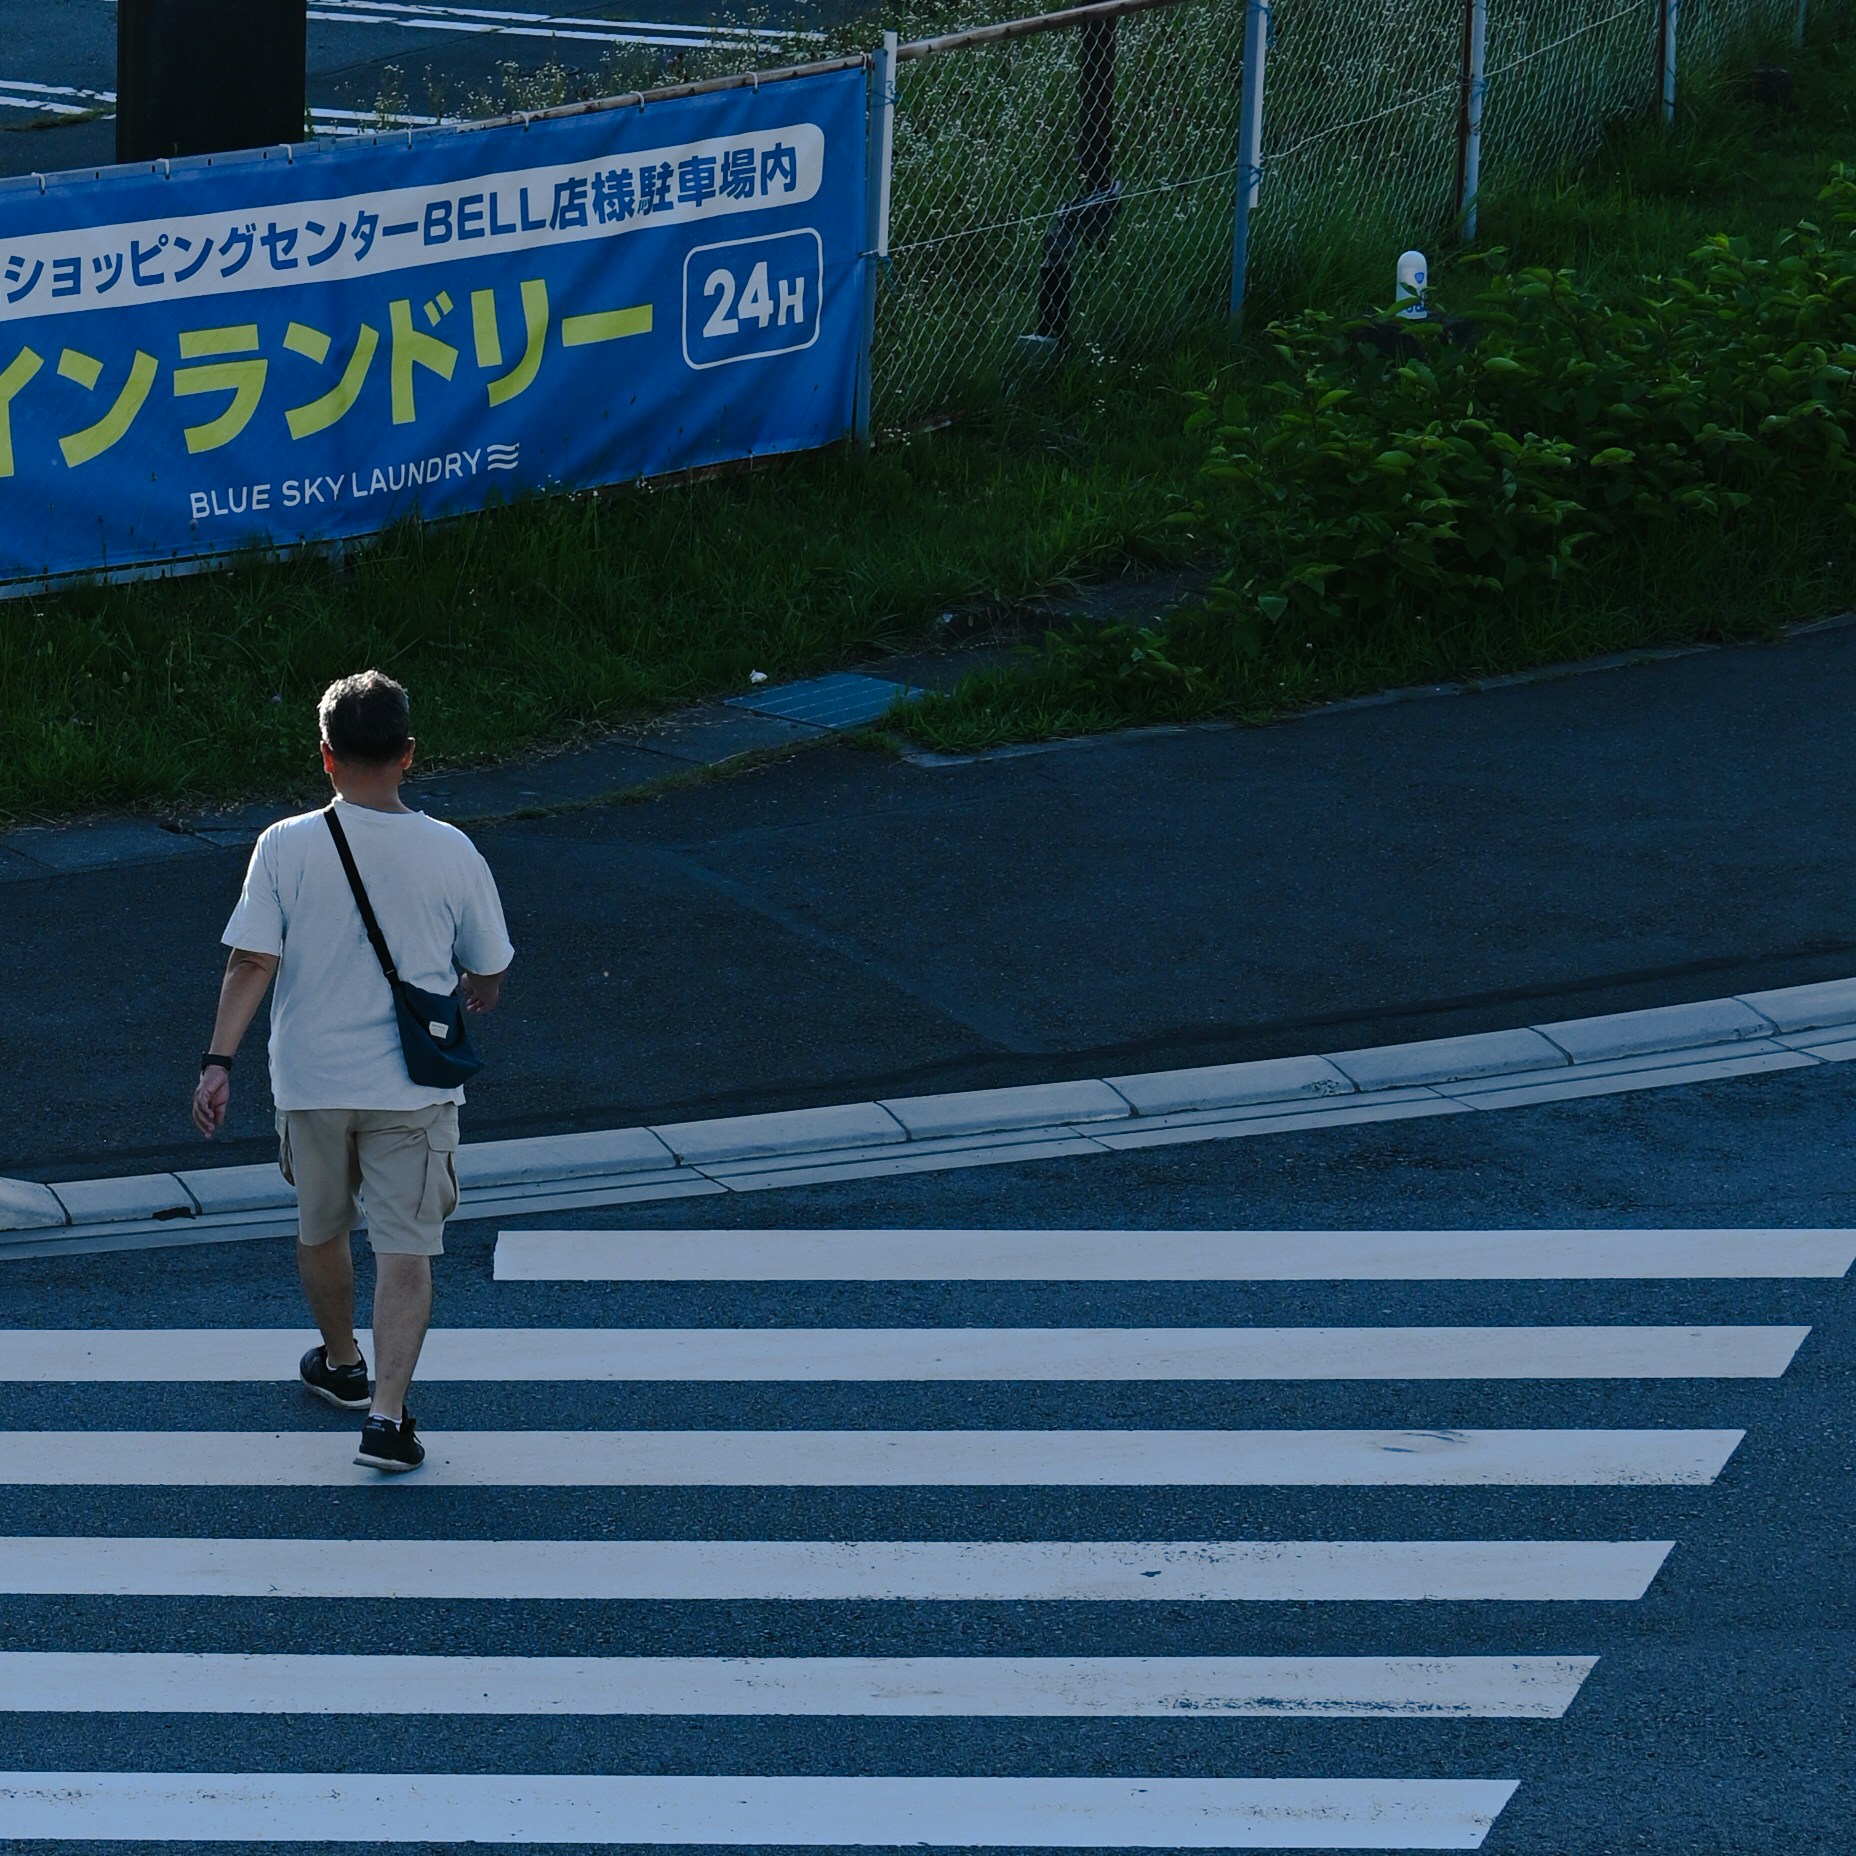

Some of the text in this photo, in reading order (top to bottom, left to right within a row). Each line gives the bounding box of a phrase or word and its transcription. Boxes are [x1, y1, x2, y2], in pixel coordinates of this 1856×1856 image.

[702, 260, 806, 339] 24H
[189, 447, 482, 519] BLUE SKY LAUNDRY
